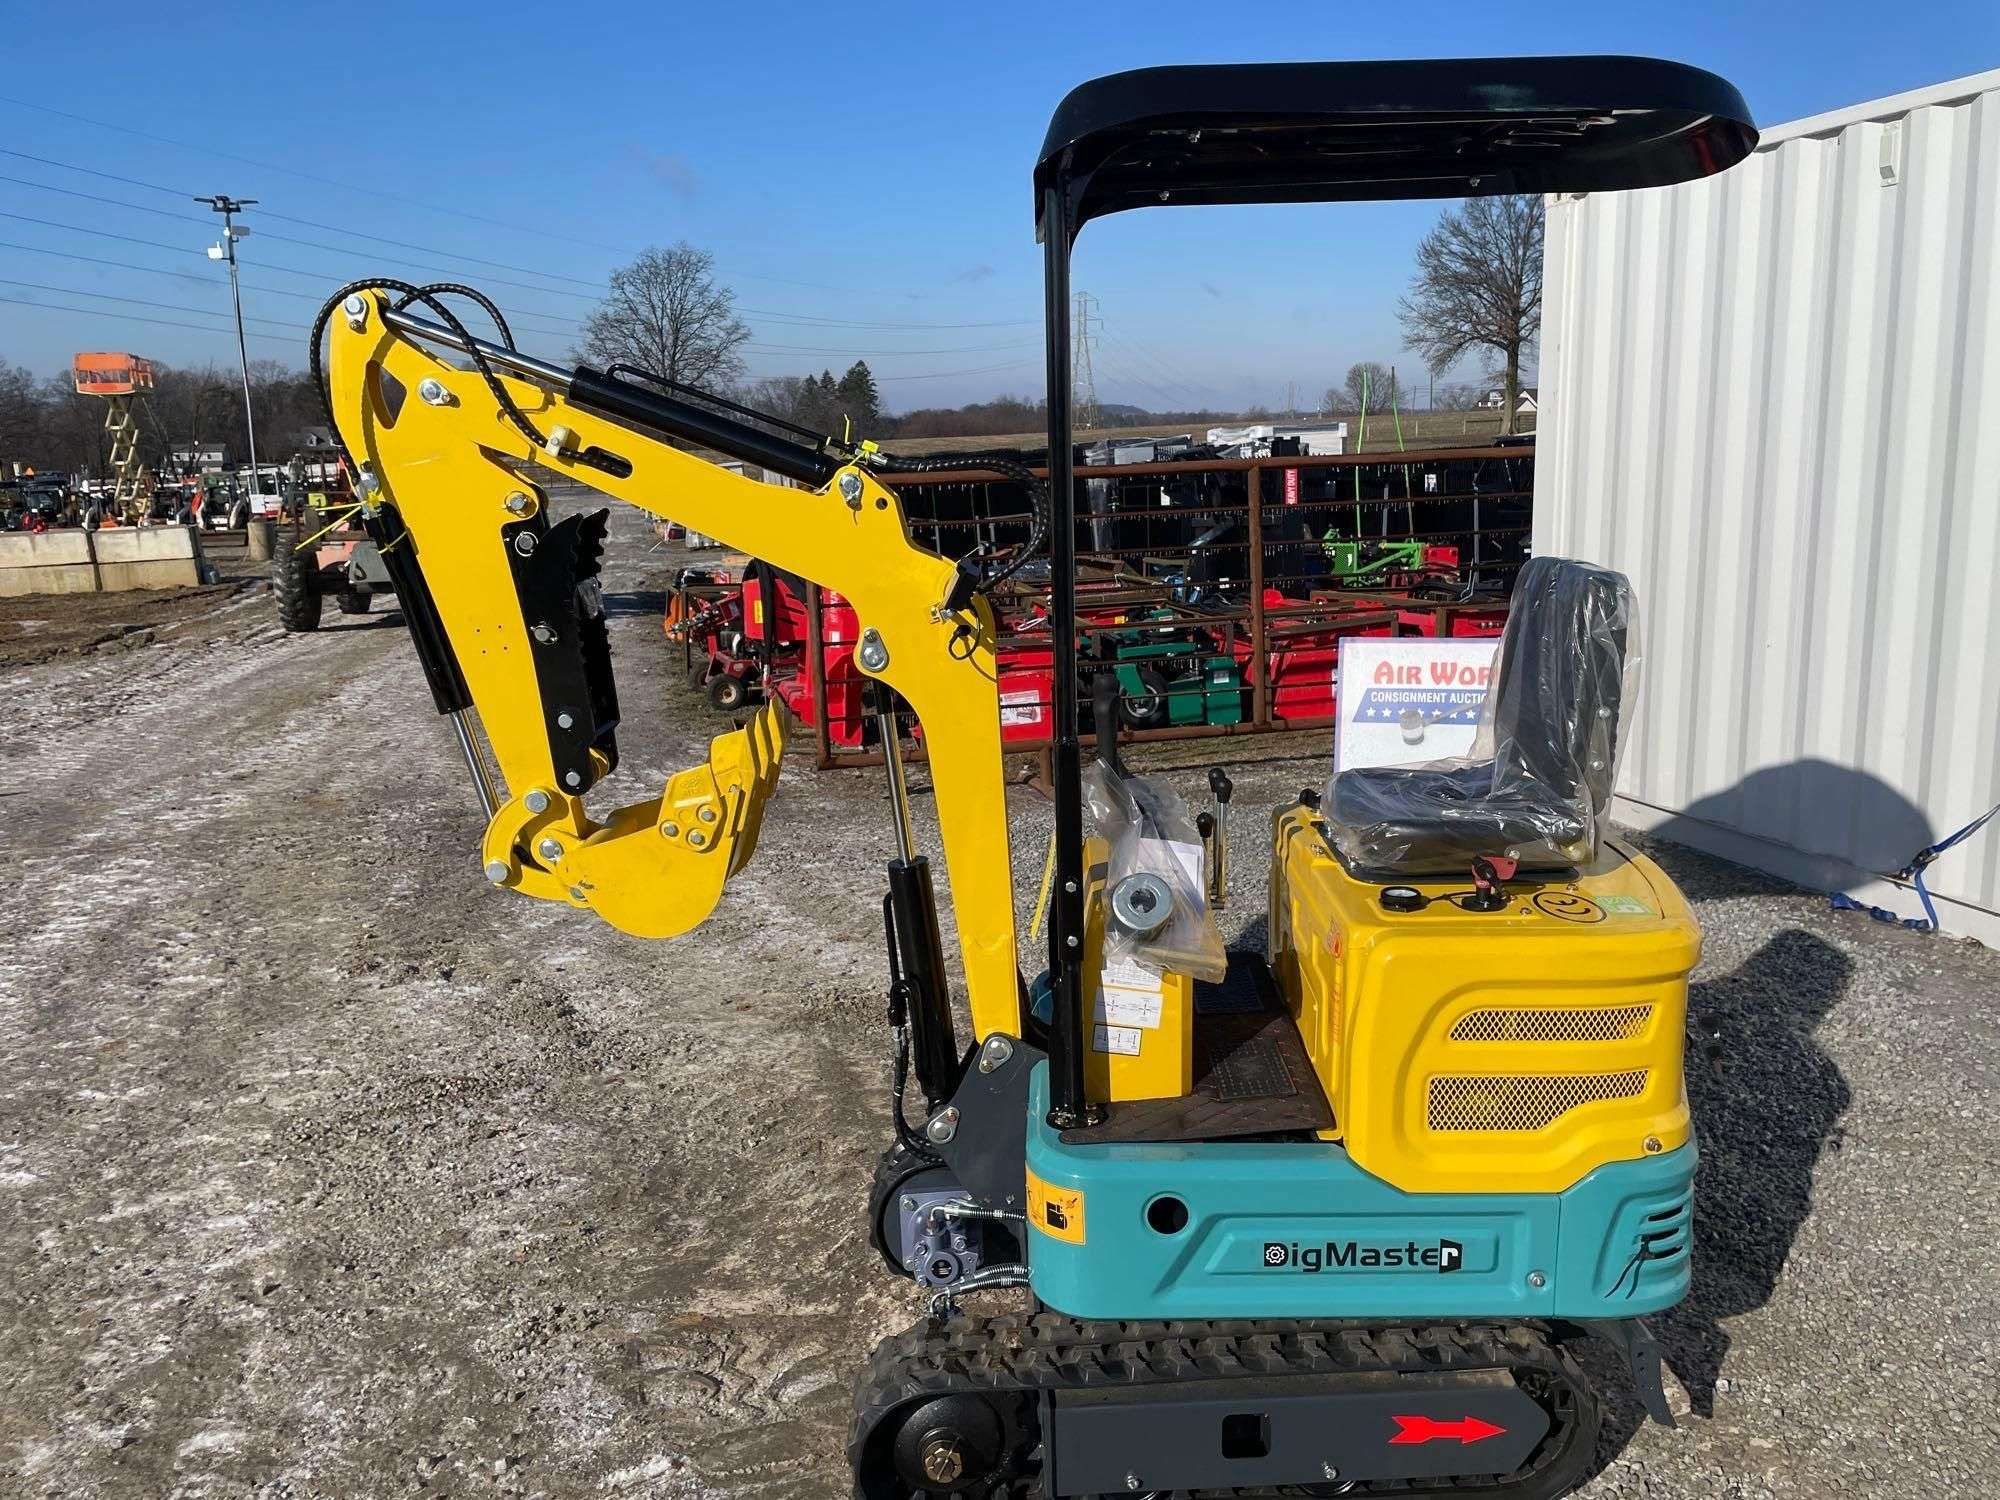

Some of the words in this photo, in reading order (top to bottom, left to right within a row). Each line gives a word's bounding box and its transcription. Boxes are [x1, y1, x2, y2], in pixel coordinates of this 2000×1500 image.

[1374, 660, 1422, 685] AIR
[1371, 691, 1446, 703] CONSIGNMENT
[1263, 1239, 1463, 1273] DigMaster
